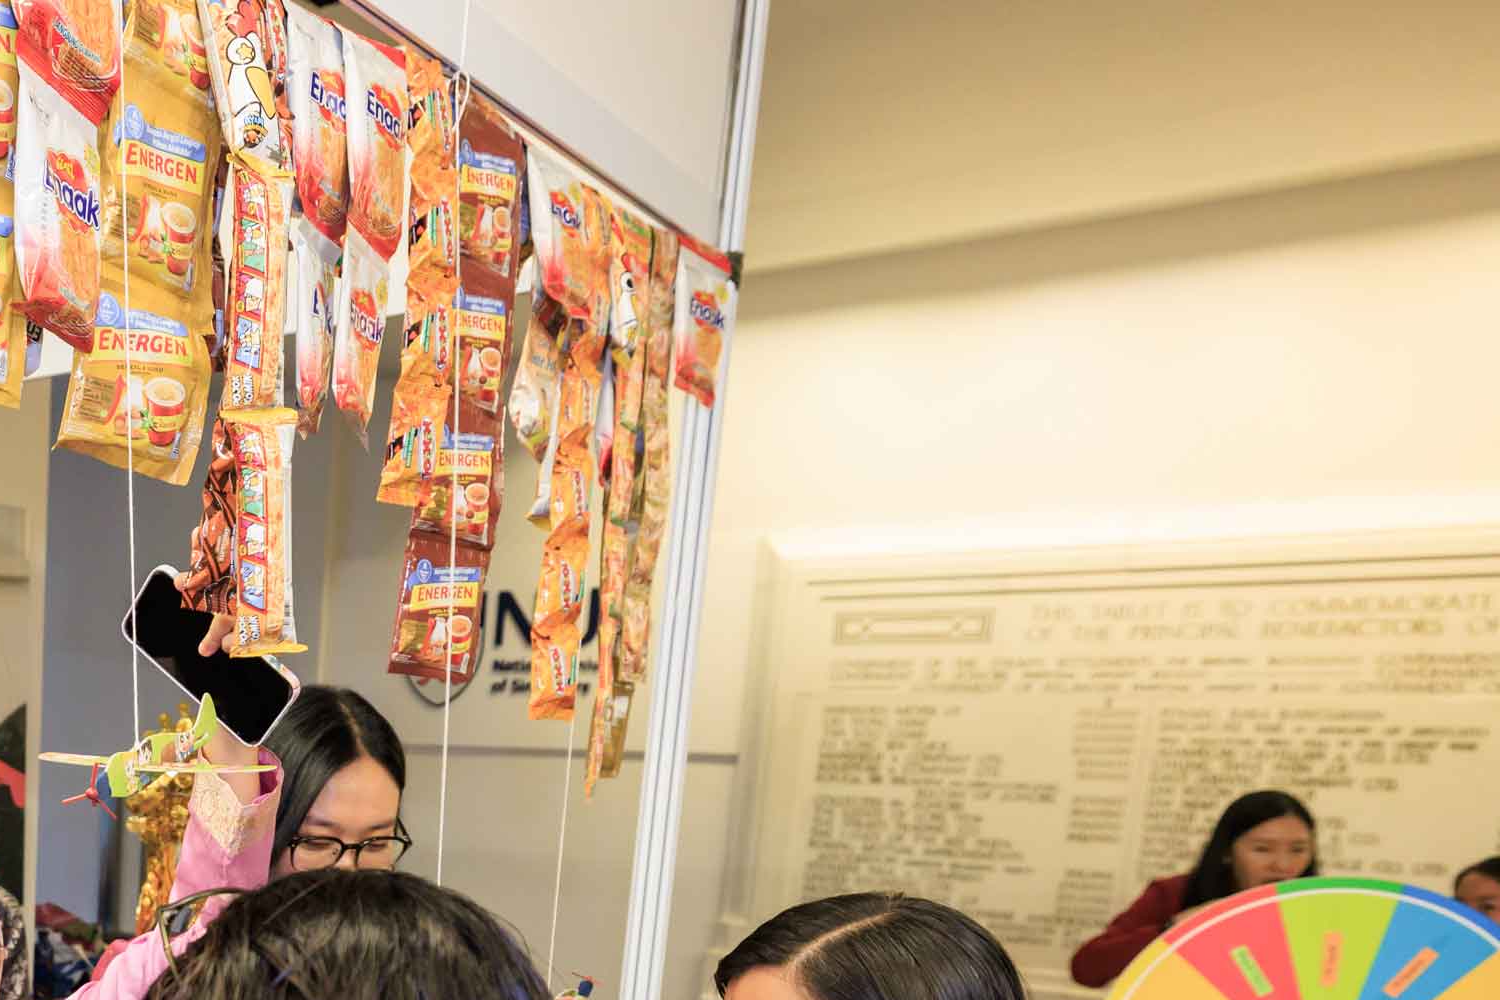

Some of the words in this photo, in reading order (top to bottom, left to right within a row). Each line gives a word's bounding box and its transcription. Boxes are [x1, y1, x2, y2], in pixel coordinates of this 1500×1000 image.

[126, 143, 197, 184] ENERGEN
[99, 329, 188, 357] ENERGEN
[439, 452, 489, 468] ENRGEN
